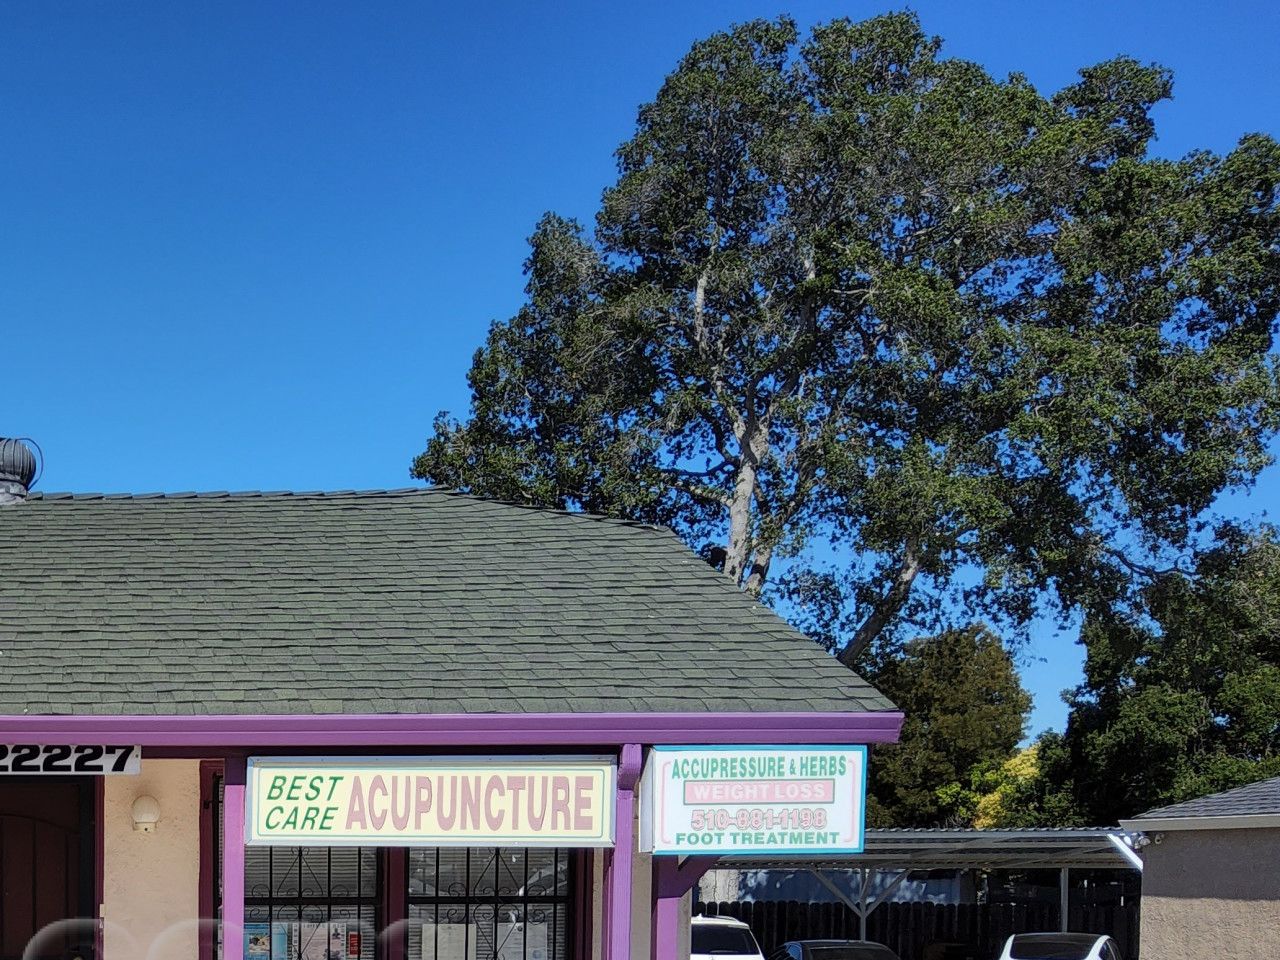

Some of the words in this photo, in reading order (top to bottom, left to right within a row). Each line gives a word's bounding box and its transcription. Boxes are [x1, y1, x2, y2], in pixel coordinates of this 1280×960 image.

[671, 756, 786, 779] ACCUPRESSURE
[789, 758, 797, 775] &
[799, 755, 847, 777] HERBS
[266, 775, 344, 801] BEST
[693, 783, 770, 800] WEIGHT
[775, 783, 825, 799] LOSS
[345, 774, 594, 831] ACUPUNCTURE
[264, 806, 339, 831] CARE
[691, 808, 828, 831] 510-881-1198
[675, 832, 727, 845] FOOT
[729, 832, 840, 845] TREATMENT
